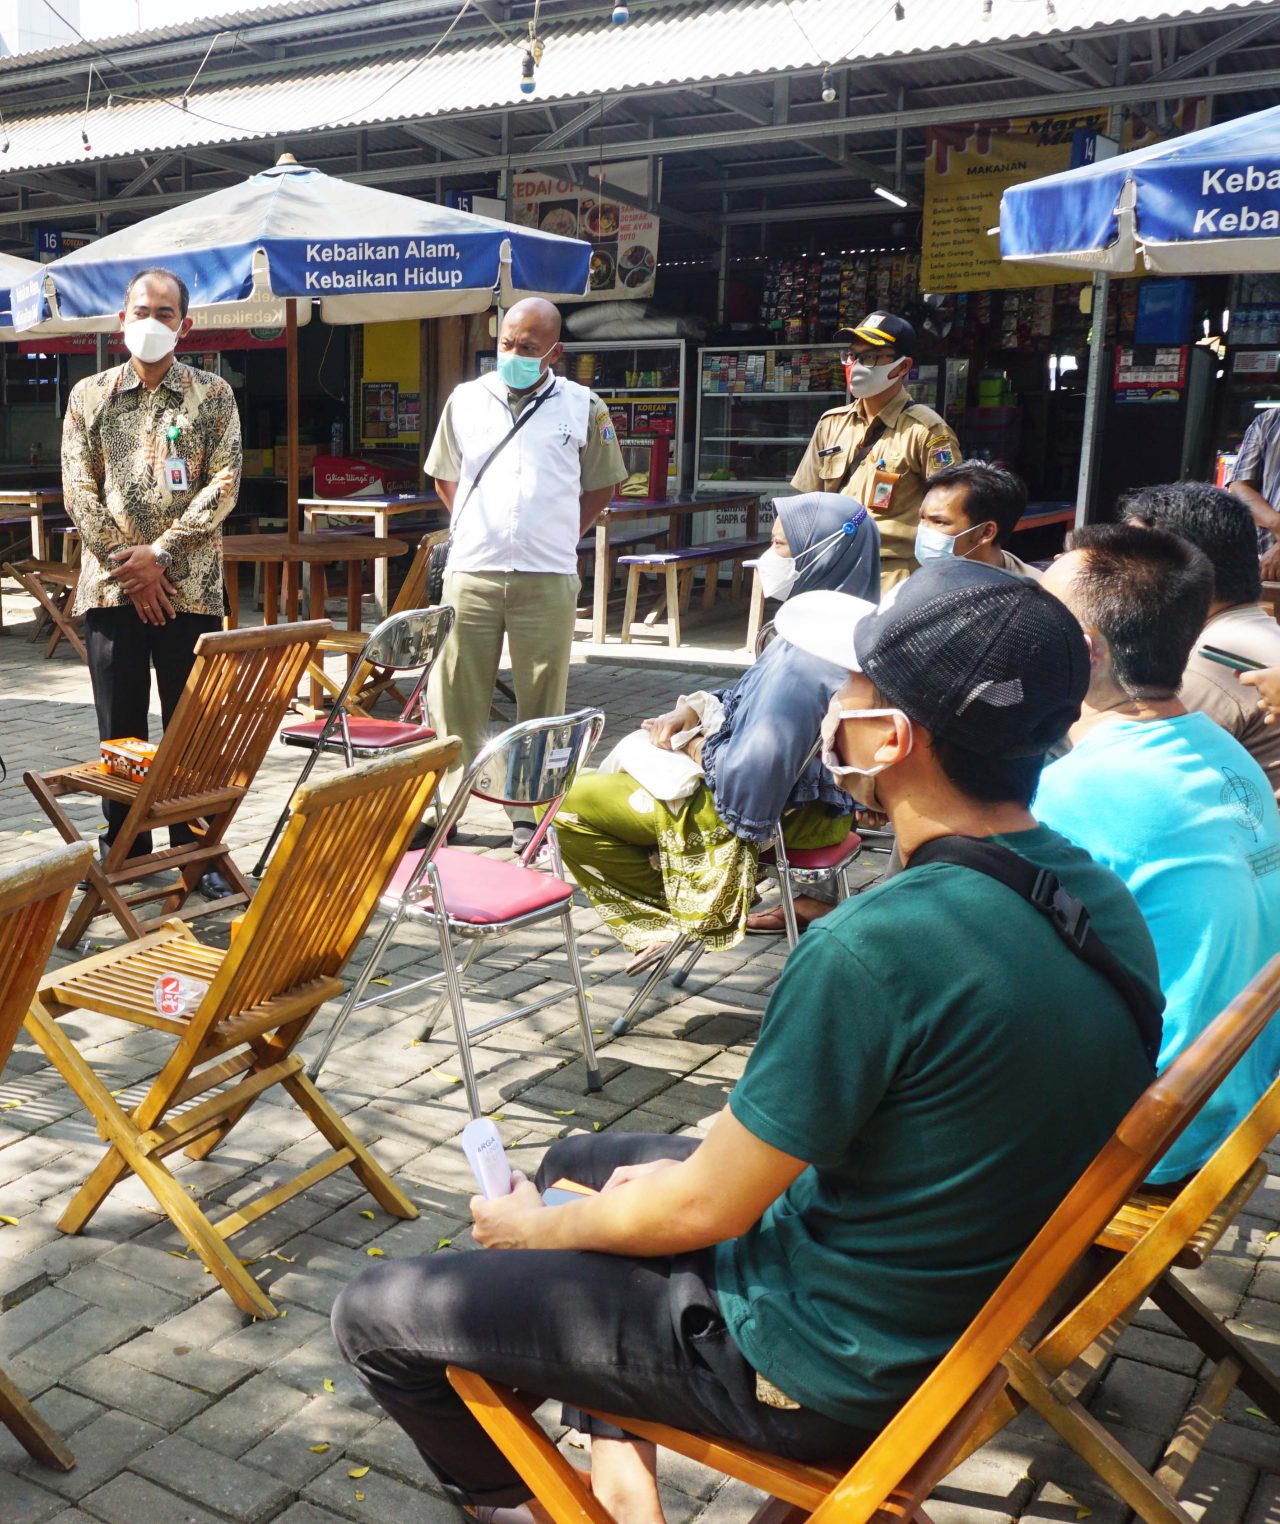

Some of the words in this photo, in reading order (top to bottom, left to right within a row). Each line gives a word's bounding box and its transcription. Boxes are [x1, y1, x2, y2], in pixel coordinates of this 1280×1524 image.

[1085, 137, 1095, 160] 14
[967, 161, 1027, 175] MAKANAN
[513, 180, 552, 199] EDAI
[458, 197, 469, 212] 15
[44, 233, 57, 249] 16
[306, 242, 399, 263] Kebaikan
[404, 240, 461, 260] Alam,
[305, 269, 398, 289] Kebaikan
[404, 267, 463, 287] Hidup
